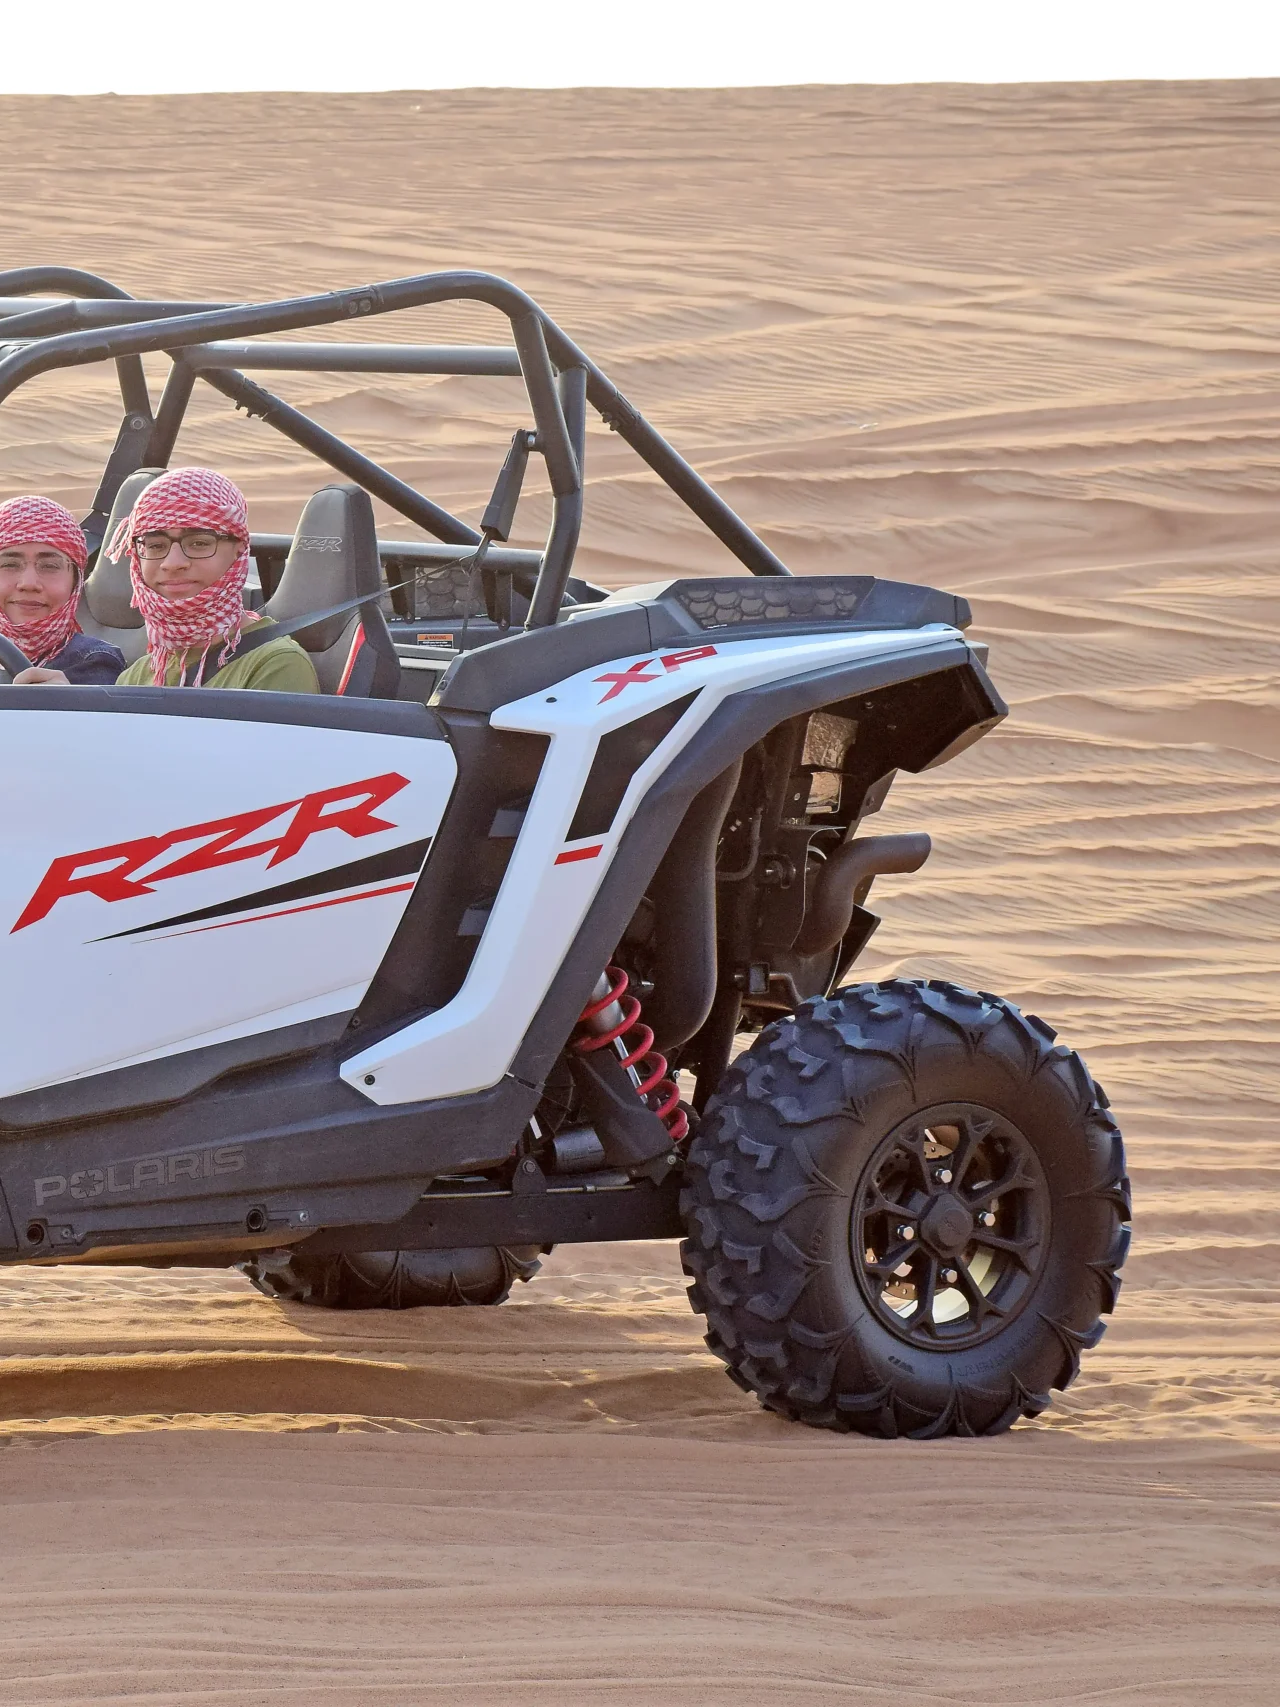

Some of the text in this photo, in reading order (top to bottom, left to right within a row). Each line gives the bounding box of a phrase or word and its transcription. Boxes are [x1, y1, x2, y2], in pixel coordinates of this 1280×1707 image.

[295, 536, 342, 552] RZR
[591, 645, 718, 705] XP
[10, 772, 411, 934] RZR
[34, 1144, 246, 1206] POLARIS
